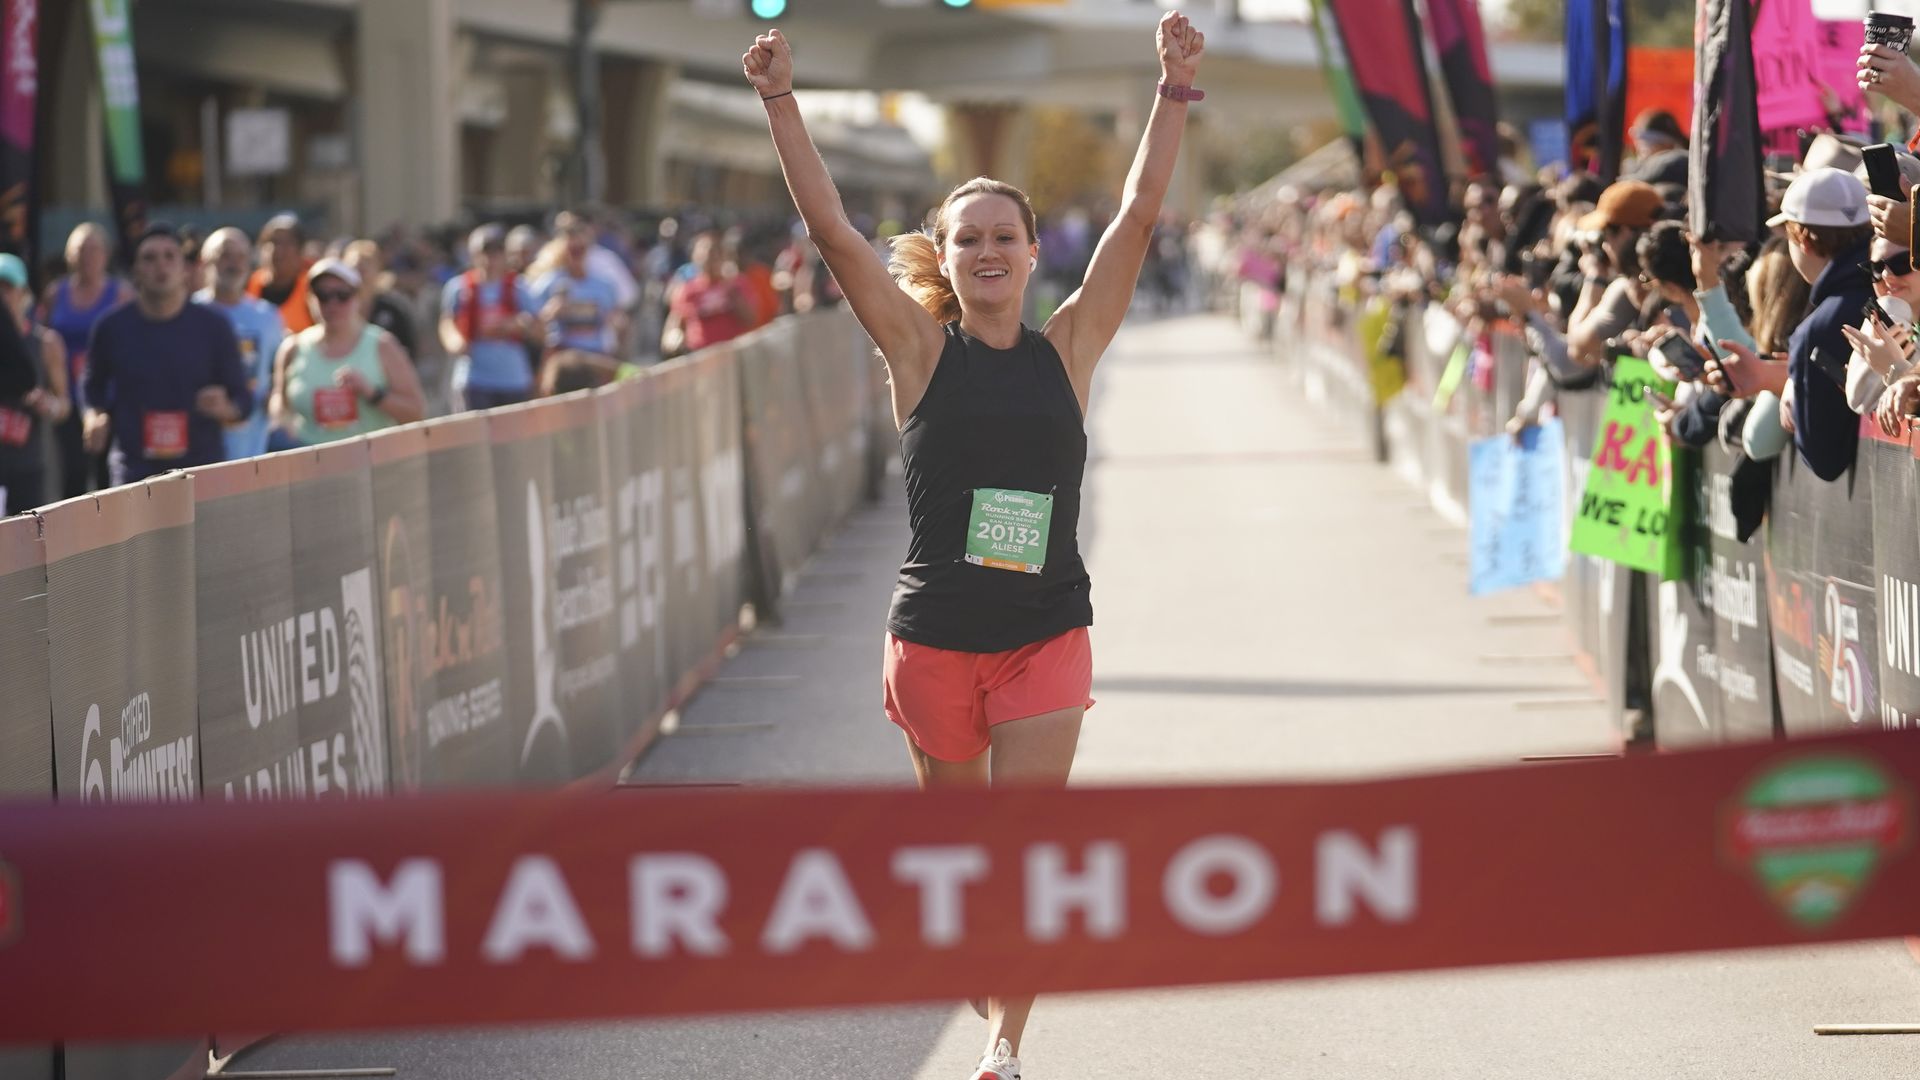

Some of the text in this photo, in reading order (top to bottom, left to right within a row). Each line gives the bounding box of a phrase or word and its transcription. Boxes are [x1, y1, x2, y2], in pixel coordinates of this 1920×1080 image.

[1613, 378, 1658, 404] YO
[981, 503, 1011, 515] Rock
[1020, 508, 1044, 520] Roll
[1581, 491, 1626, 526] WE
[976, 522, 1040, 547] 20132
[991, 542, 1024, 554] ALIESE
[241, 606, 341, 729] UNITED
[328, 825, 1420, 967] MARATHON
